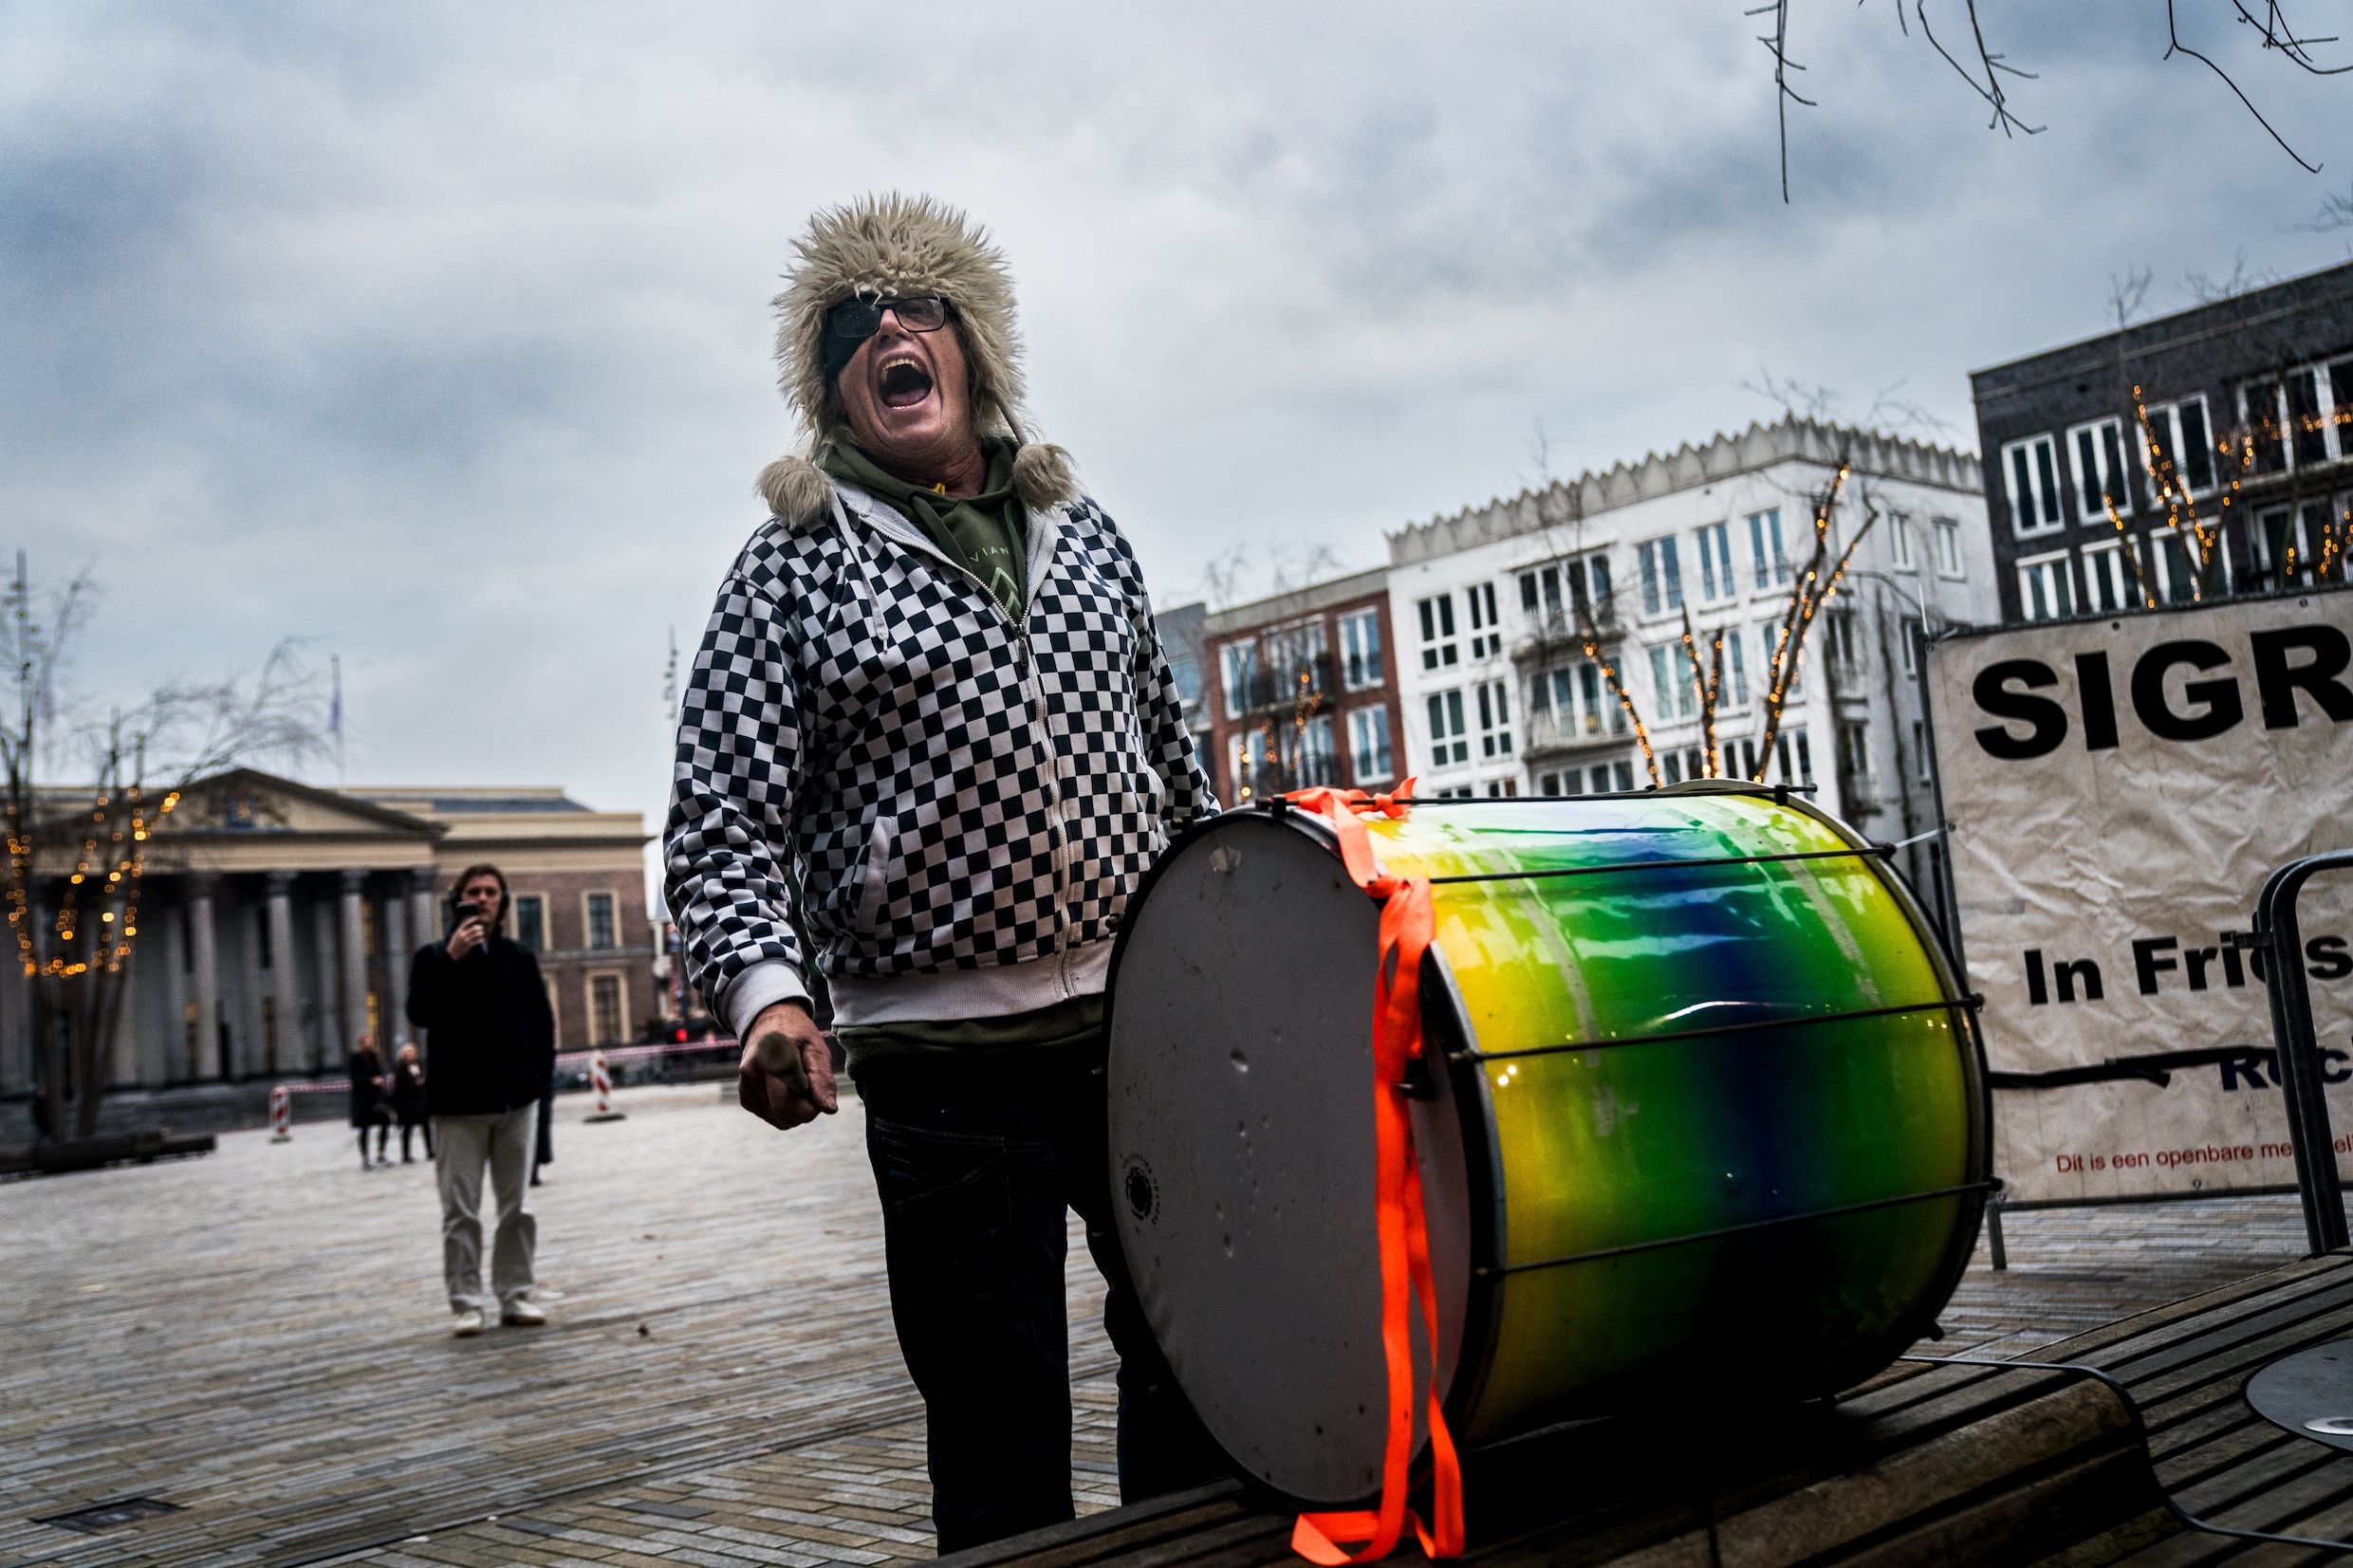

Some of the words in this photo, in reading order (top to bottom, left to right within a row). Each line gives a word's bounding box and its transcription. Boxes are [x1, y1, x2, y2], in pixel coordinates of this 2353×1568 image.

[970, 546, 1012, 563] VIAN
[1973, 624, 2353, 760] SIGR
[2024, 949, 2103, 1005] In
[2056, 1153, 2084, 1173] Dit
[2089, 1153, 2105, 1171] is
[2112, 1152, 2149, 1170] een
[2156, 1144, 2254, 1170] openbare
